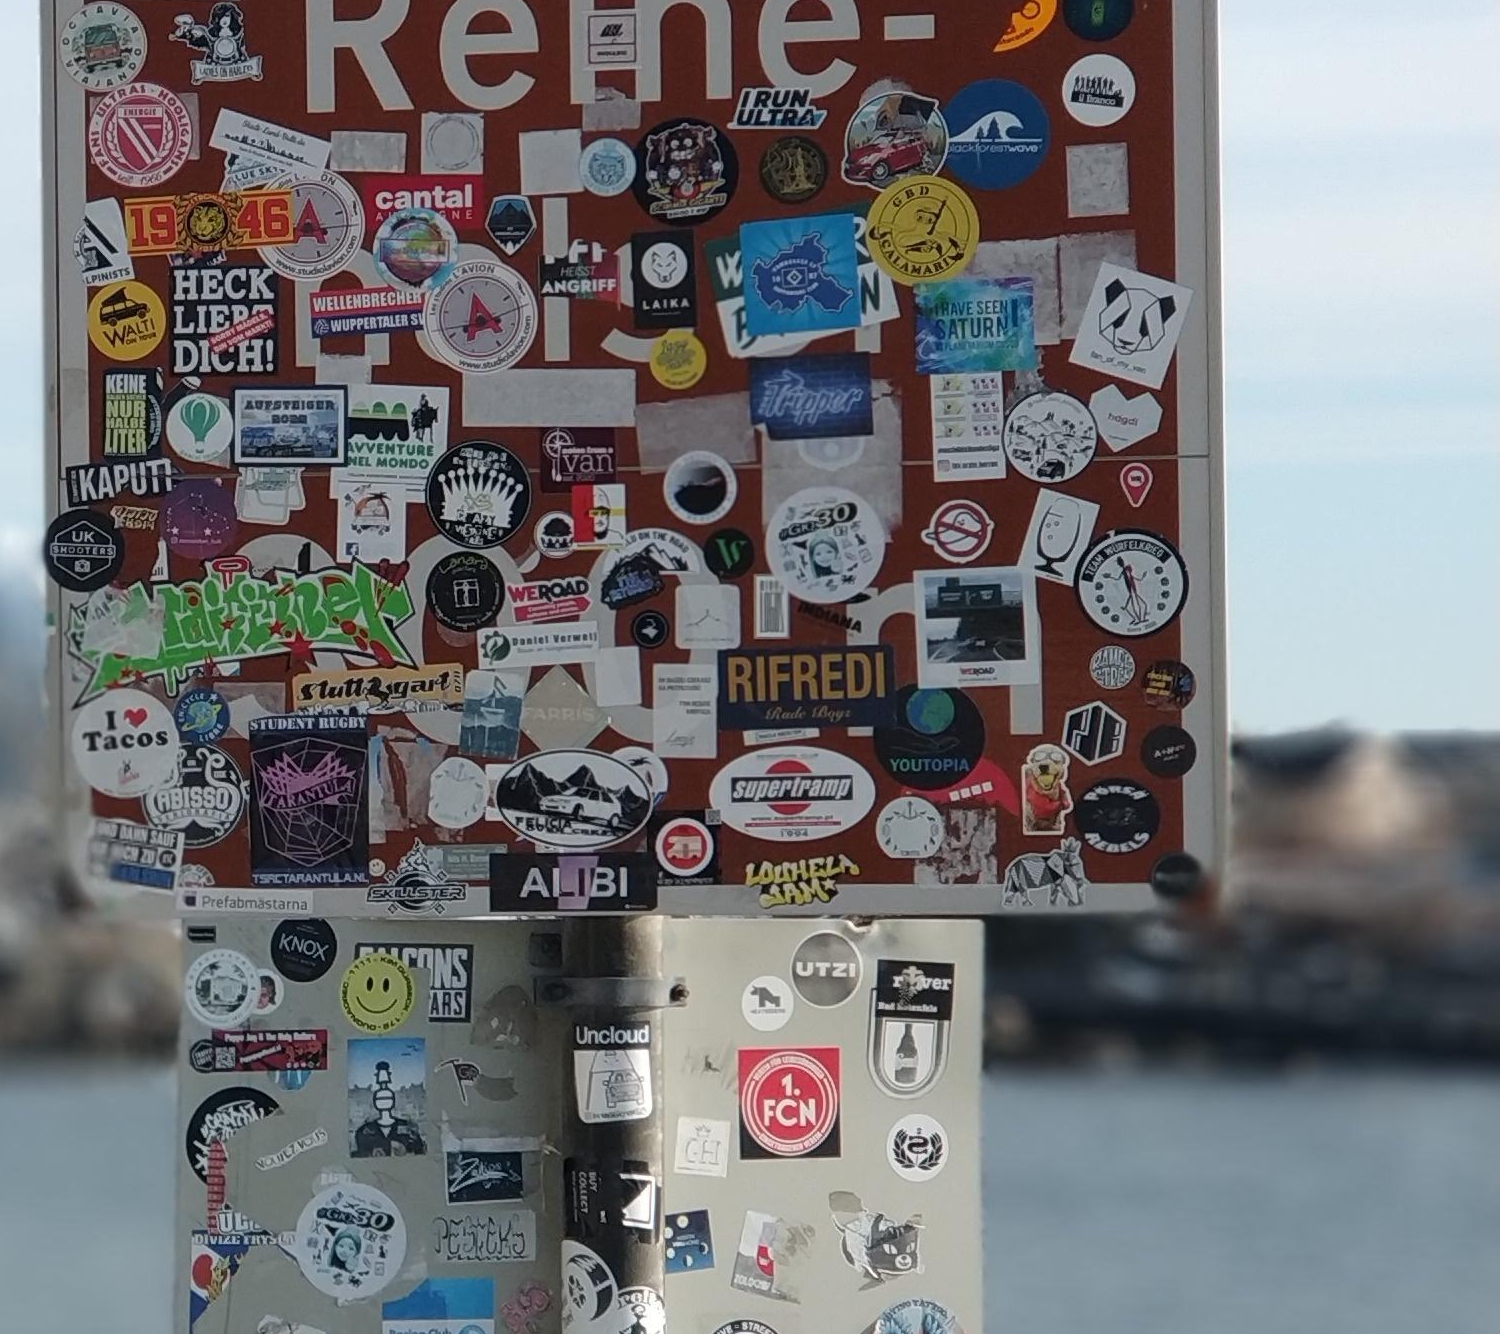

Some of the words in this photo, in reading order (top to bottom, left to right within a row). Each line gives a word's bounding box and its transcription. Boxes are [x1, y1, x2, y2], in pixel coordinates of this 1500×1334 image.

[62, 5, 139, 46] OCTAVIA
[65, 48, 142, 87] VIAJANDO
[752, 89, 810, 108] RUN
[736, 108, 817, 127] ULTRA
[158, 89, 189, 171] HOOLIGANS
[375, 183, 474, 210] cantal
[892, 185, 930, 208] GBD
[130, 205, 177, 248] 19
[236, 197, 290, 239] 46
[173, 268, 275, 301] HECK
[541, 279, 616, 294] ANGRIFF
[312, 291, 422, 313] WELLENBRECHER
[642, 299, 690, 310] LAIKA
[942, 301, 974, 316] HAVE
[976, 299, 1008, 315] SEEN
[102, 318, 156, 348] WALTI
[330, 315, 409, 332] WUPPERTALER
[173, 339, 275, 373] DICH!
[106, 374, 147, 393] KEINE
[106, 400, 146, 417] NUR
[244, 400, 336, 411] AUFSTEIGER
[105, 429, 147, 455] LITER
[348, 441, 435, 457] AVVENTURE
[375, 456, 430, 470] MONDO
[561, 453, 614, 473] van
[72, 530, 95, 543] UK
[638, 531, 651, 540] ON
[652, 531, 666, 541] THE
[669, 535, 690, 554] ROAD
[52, 545, 115, 556] SHOOTERS
[507, 578, 590, 602] WEROAD
[797, 603, 863, 634] INDIANA
[512, 633, 550, 646] Daniel
[298, 671, 451, 702] Stuttgart
[727, 651, 886, 704] RIFREDI
[105, 710, 117, 730] I
[249, 717, 316, 731] STUDENT
[319, 716, 367, 730] RUGBY
[82, 730, 169, 752] Tacos
[889, 758, 970, 773] YOUTOPIA
[157, 786, 230, 811] ABISSO
[266, 779, 353, 808] TARANTULA
[733, 777, 852, 803] supertramp
[514, 816, 573, 829] FELICIA
[149, 829, 177, 847] SAUF
[1084, 830, 1150, 854] REBELS
[370, 886, 464, 900] SKILLSTER
[519, 867, 628, 898] ALIBI
[202, 894, 308, 911] Prefabmästarna
[278, 933, 329, 962] KNOX
[795, 961, 857, 978] UTZI
[575, 1024, 650, 1046] Uncloud
[781, 1073, 800, 1097] 1.
[763, 1098, 817, 1128] FCN
[578, 1171, 589, 1214] COLLECT
[589, 1171, 598, 1193] BUY
